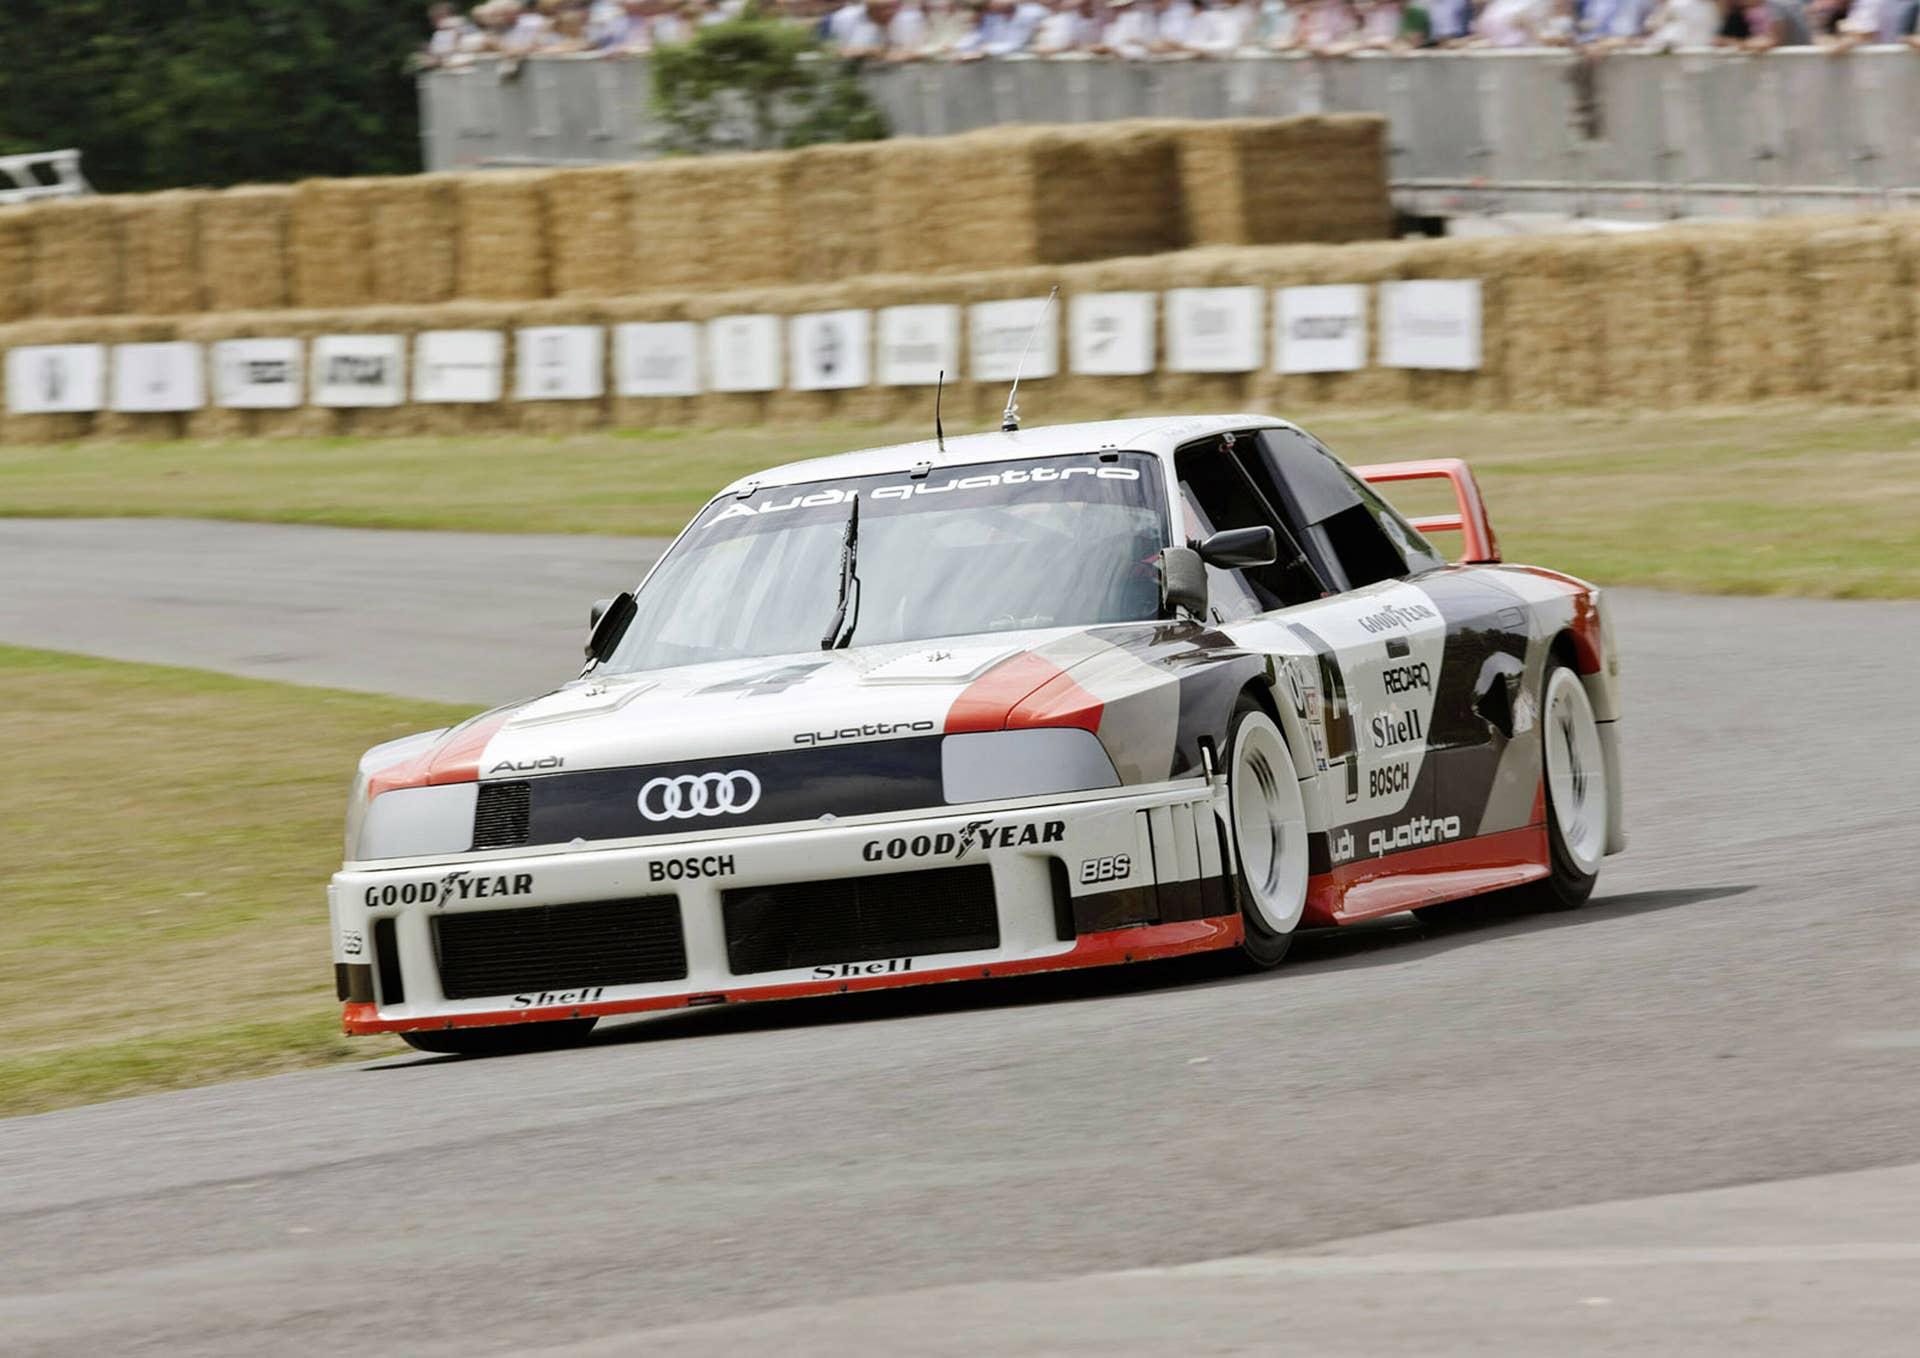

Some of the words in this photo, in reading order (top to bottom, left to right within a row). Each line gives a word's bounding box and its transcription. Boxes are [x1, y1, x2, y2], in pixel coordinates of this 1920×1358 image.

[702, 489, 859, 529] Audi
[870, 466, 1140, 500] quattro
[793, 720, 934, 745] quattro
[1372, 708, 1422, 749] Shell
[489, 756, 565, 774] Audi
[1369, 761, 1410, 799] BOSCH
[1331, 828, 1355, 862] udi
[1368, 815, 1461, 859] quattro
[648, 854, 736, 882] BOSCH
[1080, 853, 1131, 885] BBS
[812, 958, 913, 980] Shell
[509, 987, 604, 1009] Shell
